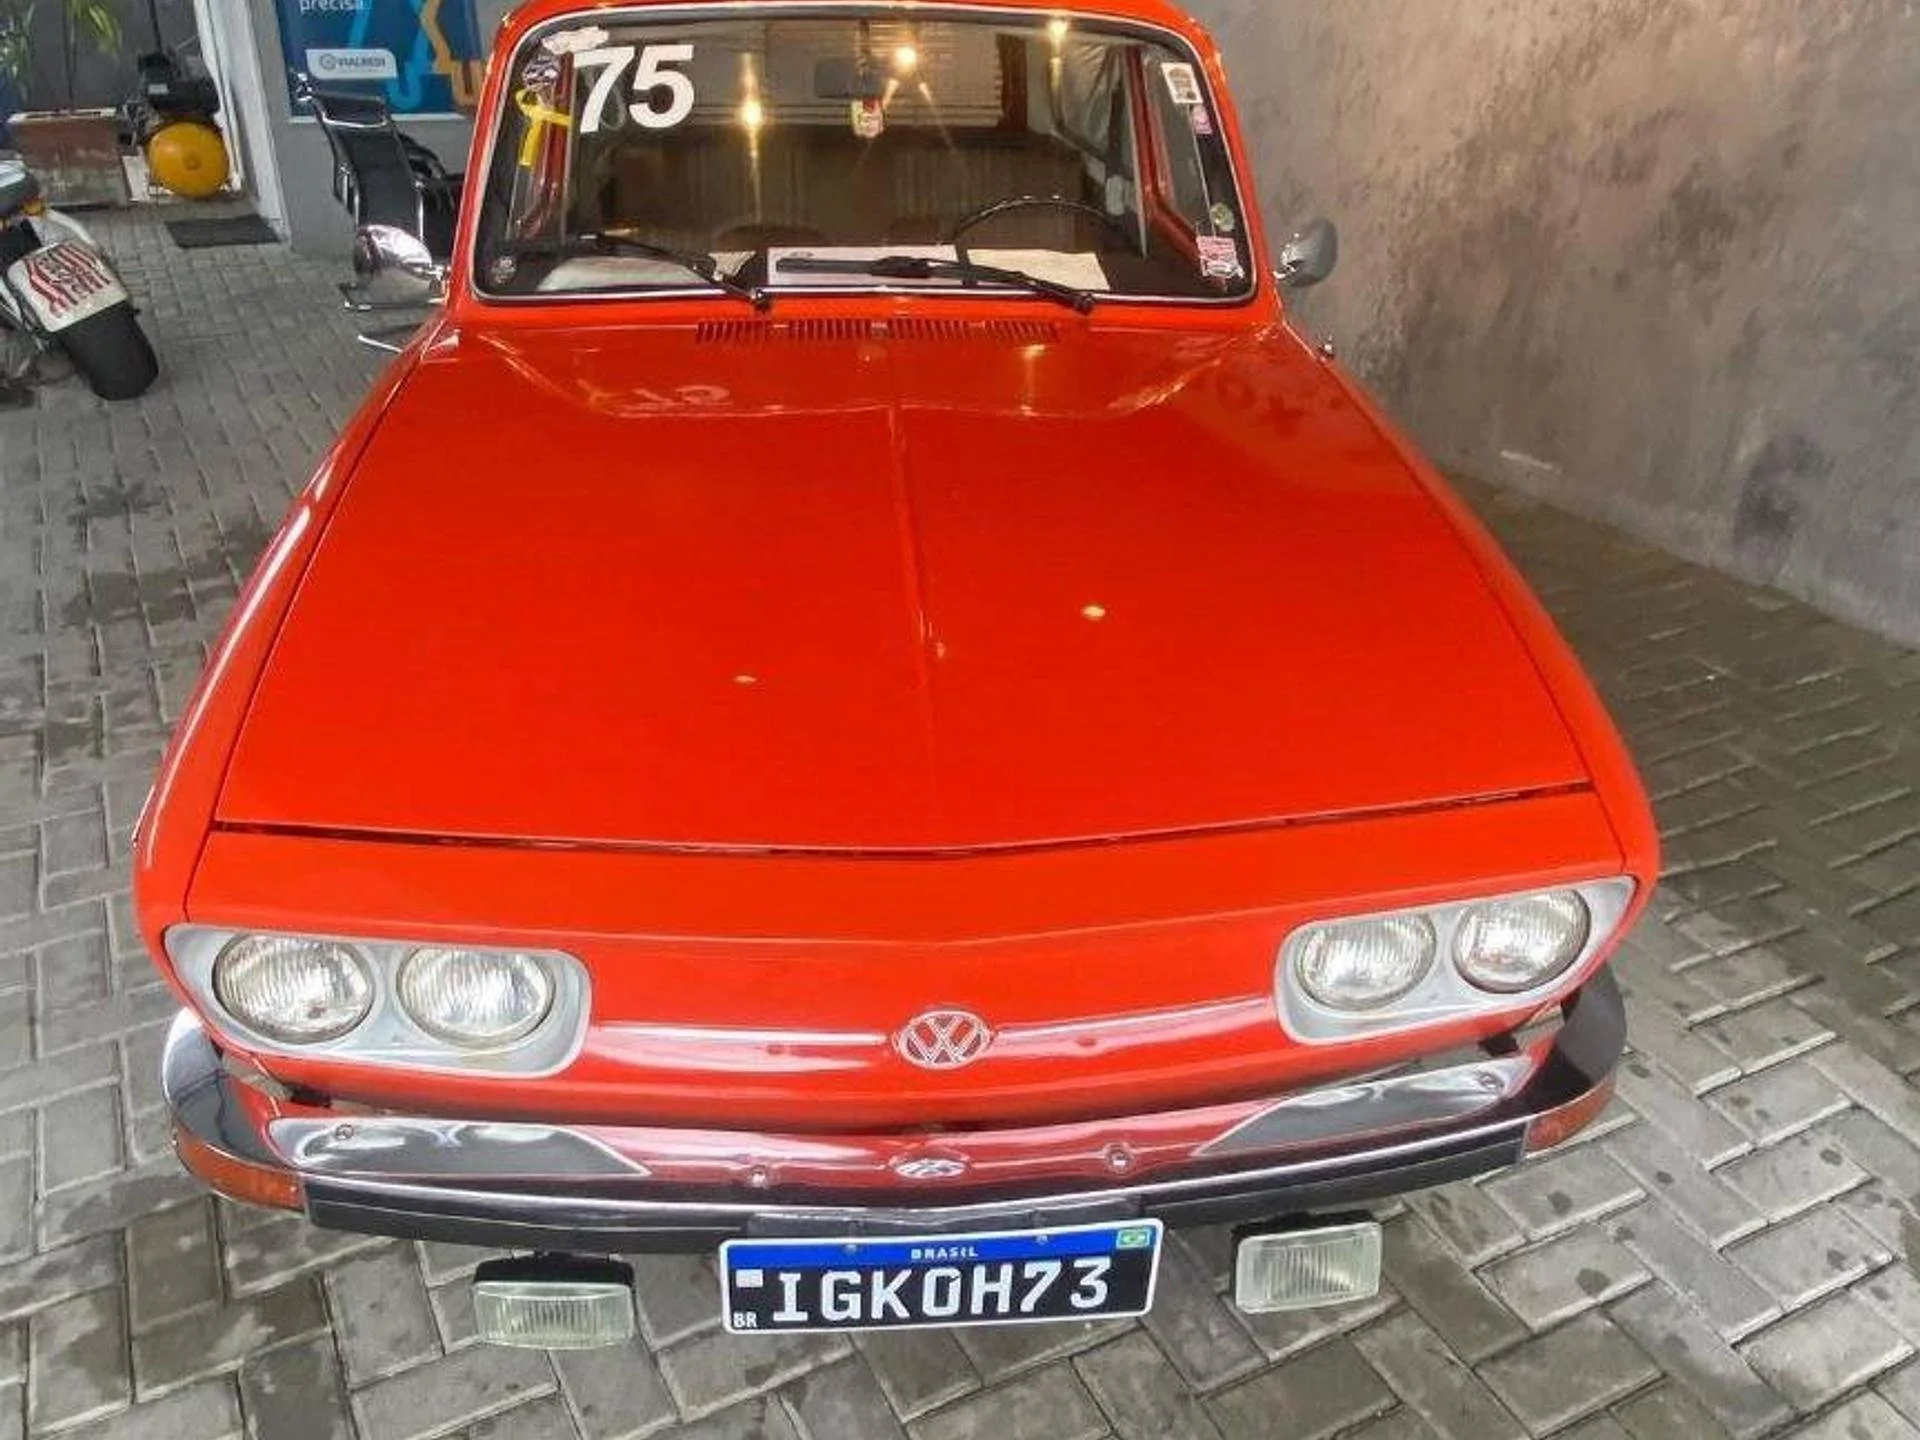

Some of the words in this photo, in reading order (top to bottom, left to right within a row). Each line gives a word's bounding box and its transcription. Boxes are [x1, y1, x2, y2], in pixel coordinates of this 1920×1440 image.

[574, 44, 694, 133] 75
[911, 1246, 979, 1260] BRASIL
[733, 1311, 758, 1329] BR
